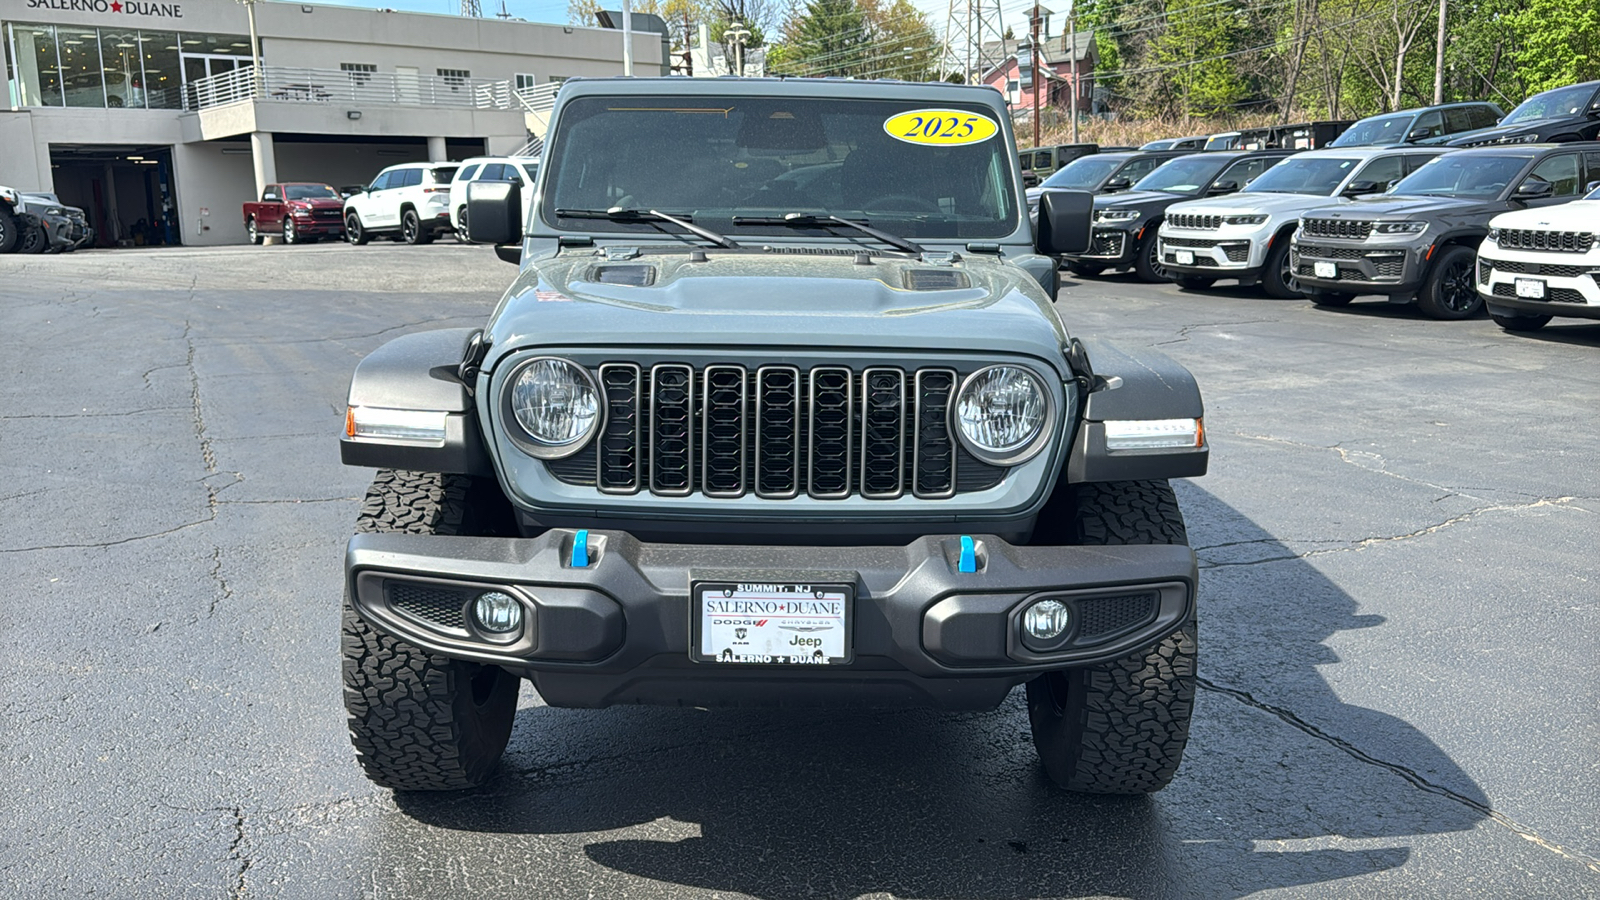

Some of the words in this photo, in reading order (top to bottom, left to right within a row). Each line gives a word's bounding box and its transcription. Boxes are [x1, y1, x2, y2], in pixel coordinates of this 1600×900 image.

[125, 1, 183, 18] DUANE
[903, 117, 978, 138] 2025
[795, 585, 811, 593] NJ
[707, 601, 777, 613] SALERNO
[787, 602, 841, 614] DUANE
[789, 635, 822, 648] Jeep
[716, 654, 771, 663] SALERNO
[790, 655, 830, 664] DUANE
